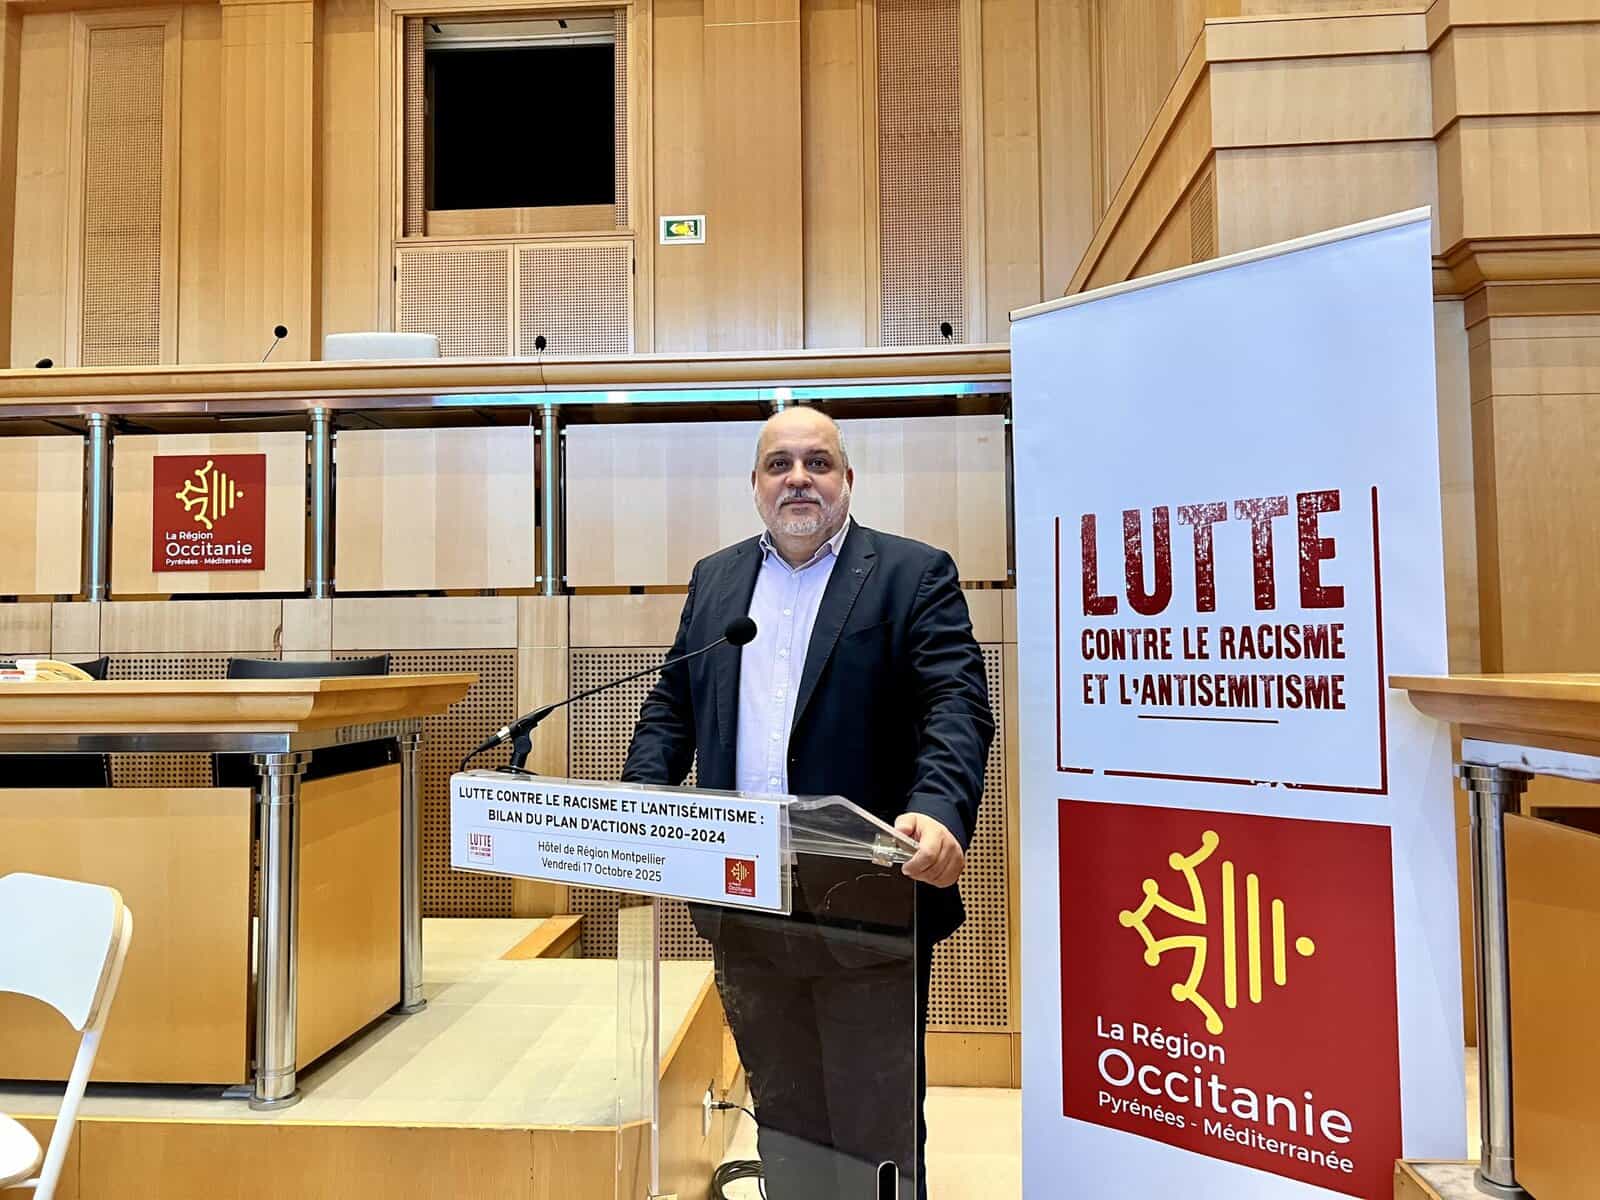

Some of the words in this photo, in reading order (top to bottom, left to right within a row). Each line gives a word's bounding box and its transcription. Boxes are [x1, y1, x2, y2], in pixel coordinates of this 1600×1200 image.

[166, 532, 177, 540] La
[179, 531, 213, 541] Région
[166, 541, 253, 556] Occitanie
[1081, 489, 1345, 617] LUTTE
[166, 558, 198, 566] Pyrénées
[204, 557, 252, 565] Méditerranée
[1081, 627, 1173, 661] CONTRE
[1183, 625, 1210, 660] LE
[1220, 623, 1346, 660] RACISME
[1083, 674, 1110, 705] ET
[1120, 673, 1346, 710] L'ANTISEMITISME
[459, 786, 494, 800] LUTTE
[497, 790, 543, 805] CONTRE
[546, 794, 560, 806] LE
[563, 795, 618, 811] RACISME
[621, 800, 637, 812] ET
[641, 802, 757, 824] L'ANTISÉMITISME
[470, 832, 491, 847] LUTTE
[488, 809, 523, 824] BILAN
[526, 813, 543, 825] DU
[546, 815, 577, 828] PLAN
[581, 818, 647, 836] D'ACTIONS
[650, 825, 726, 843] 2020-2024
[538, 840, 561, 853] Hôtel
[563, 844, 575, 855] de
[577, 845, 609, 860] Région
[611, 849, 666, 865] Montpellier
[541, 857, 581, 872] Vendredi
[583, 863, 593, 873] 17
[595, 864, 633, 878] Octobre
[635, 869, 662, 882] 2025
[1096, 1015, 1125, 1041] La
[1133, 1022, 1226, 1065] Région
[1097, 1048, 1354, 1144] Occitanie
[1098, 1091, 1185, 1129] Pyrénées
[1204, 1118, 1354, 1173] Méditerranée
